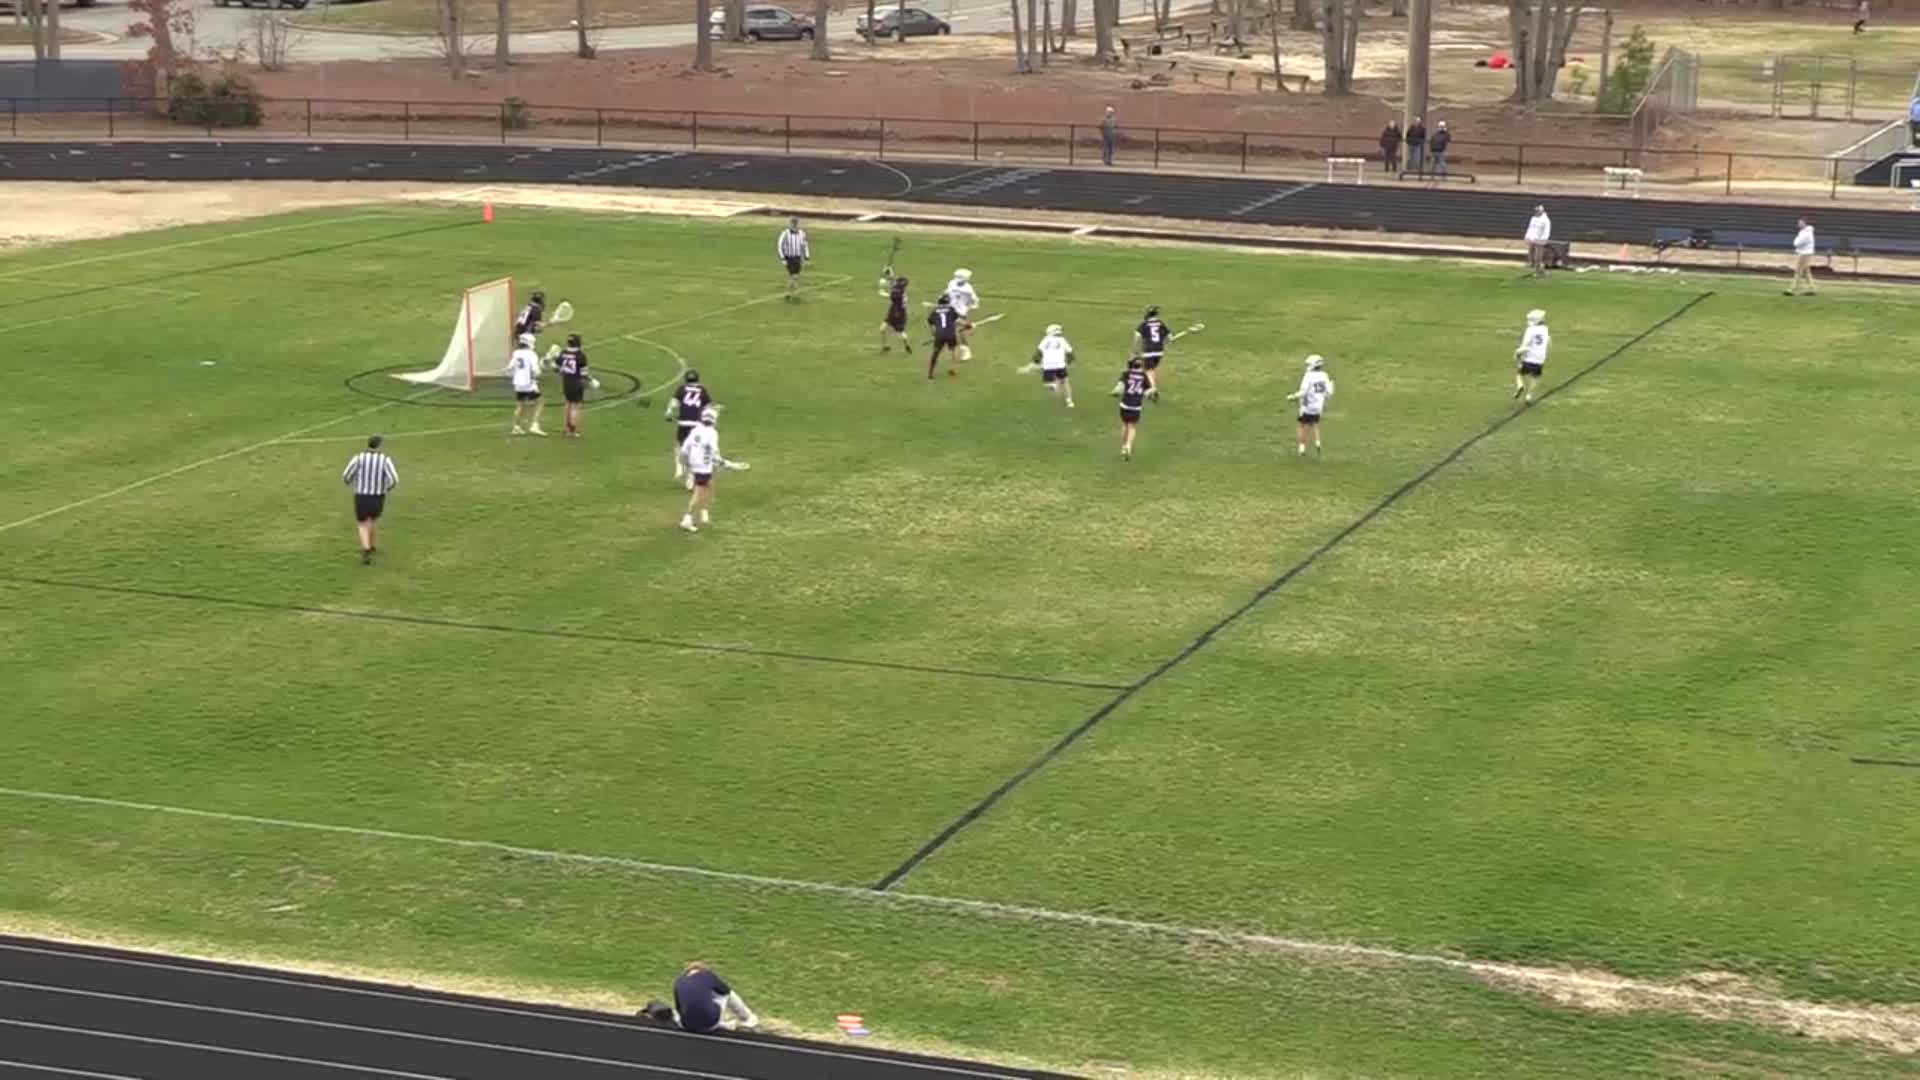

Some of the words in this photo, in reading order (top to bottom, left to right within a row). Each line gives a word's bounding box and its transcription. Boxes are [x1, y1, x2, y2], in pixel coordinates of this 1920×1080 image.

[940, 312, 947, 329] 1
[1150, 326, 1160, 342] 5
[1128, 380, 1143, 394] 24
[682, 391, 701, 408] 44
